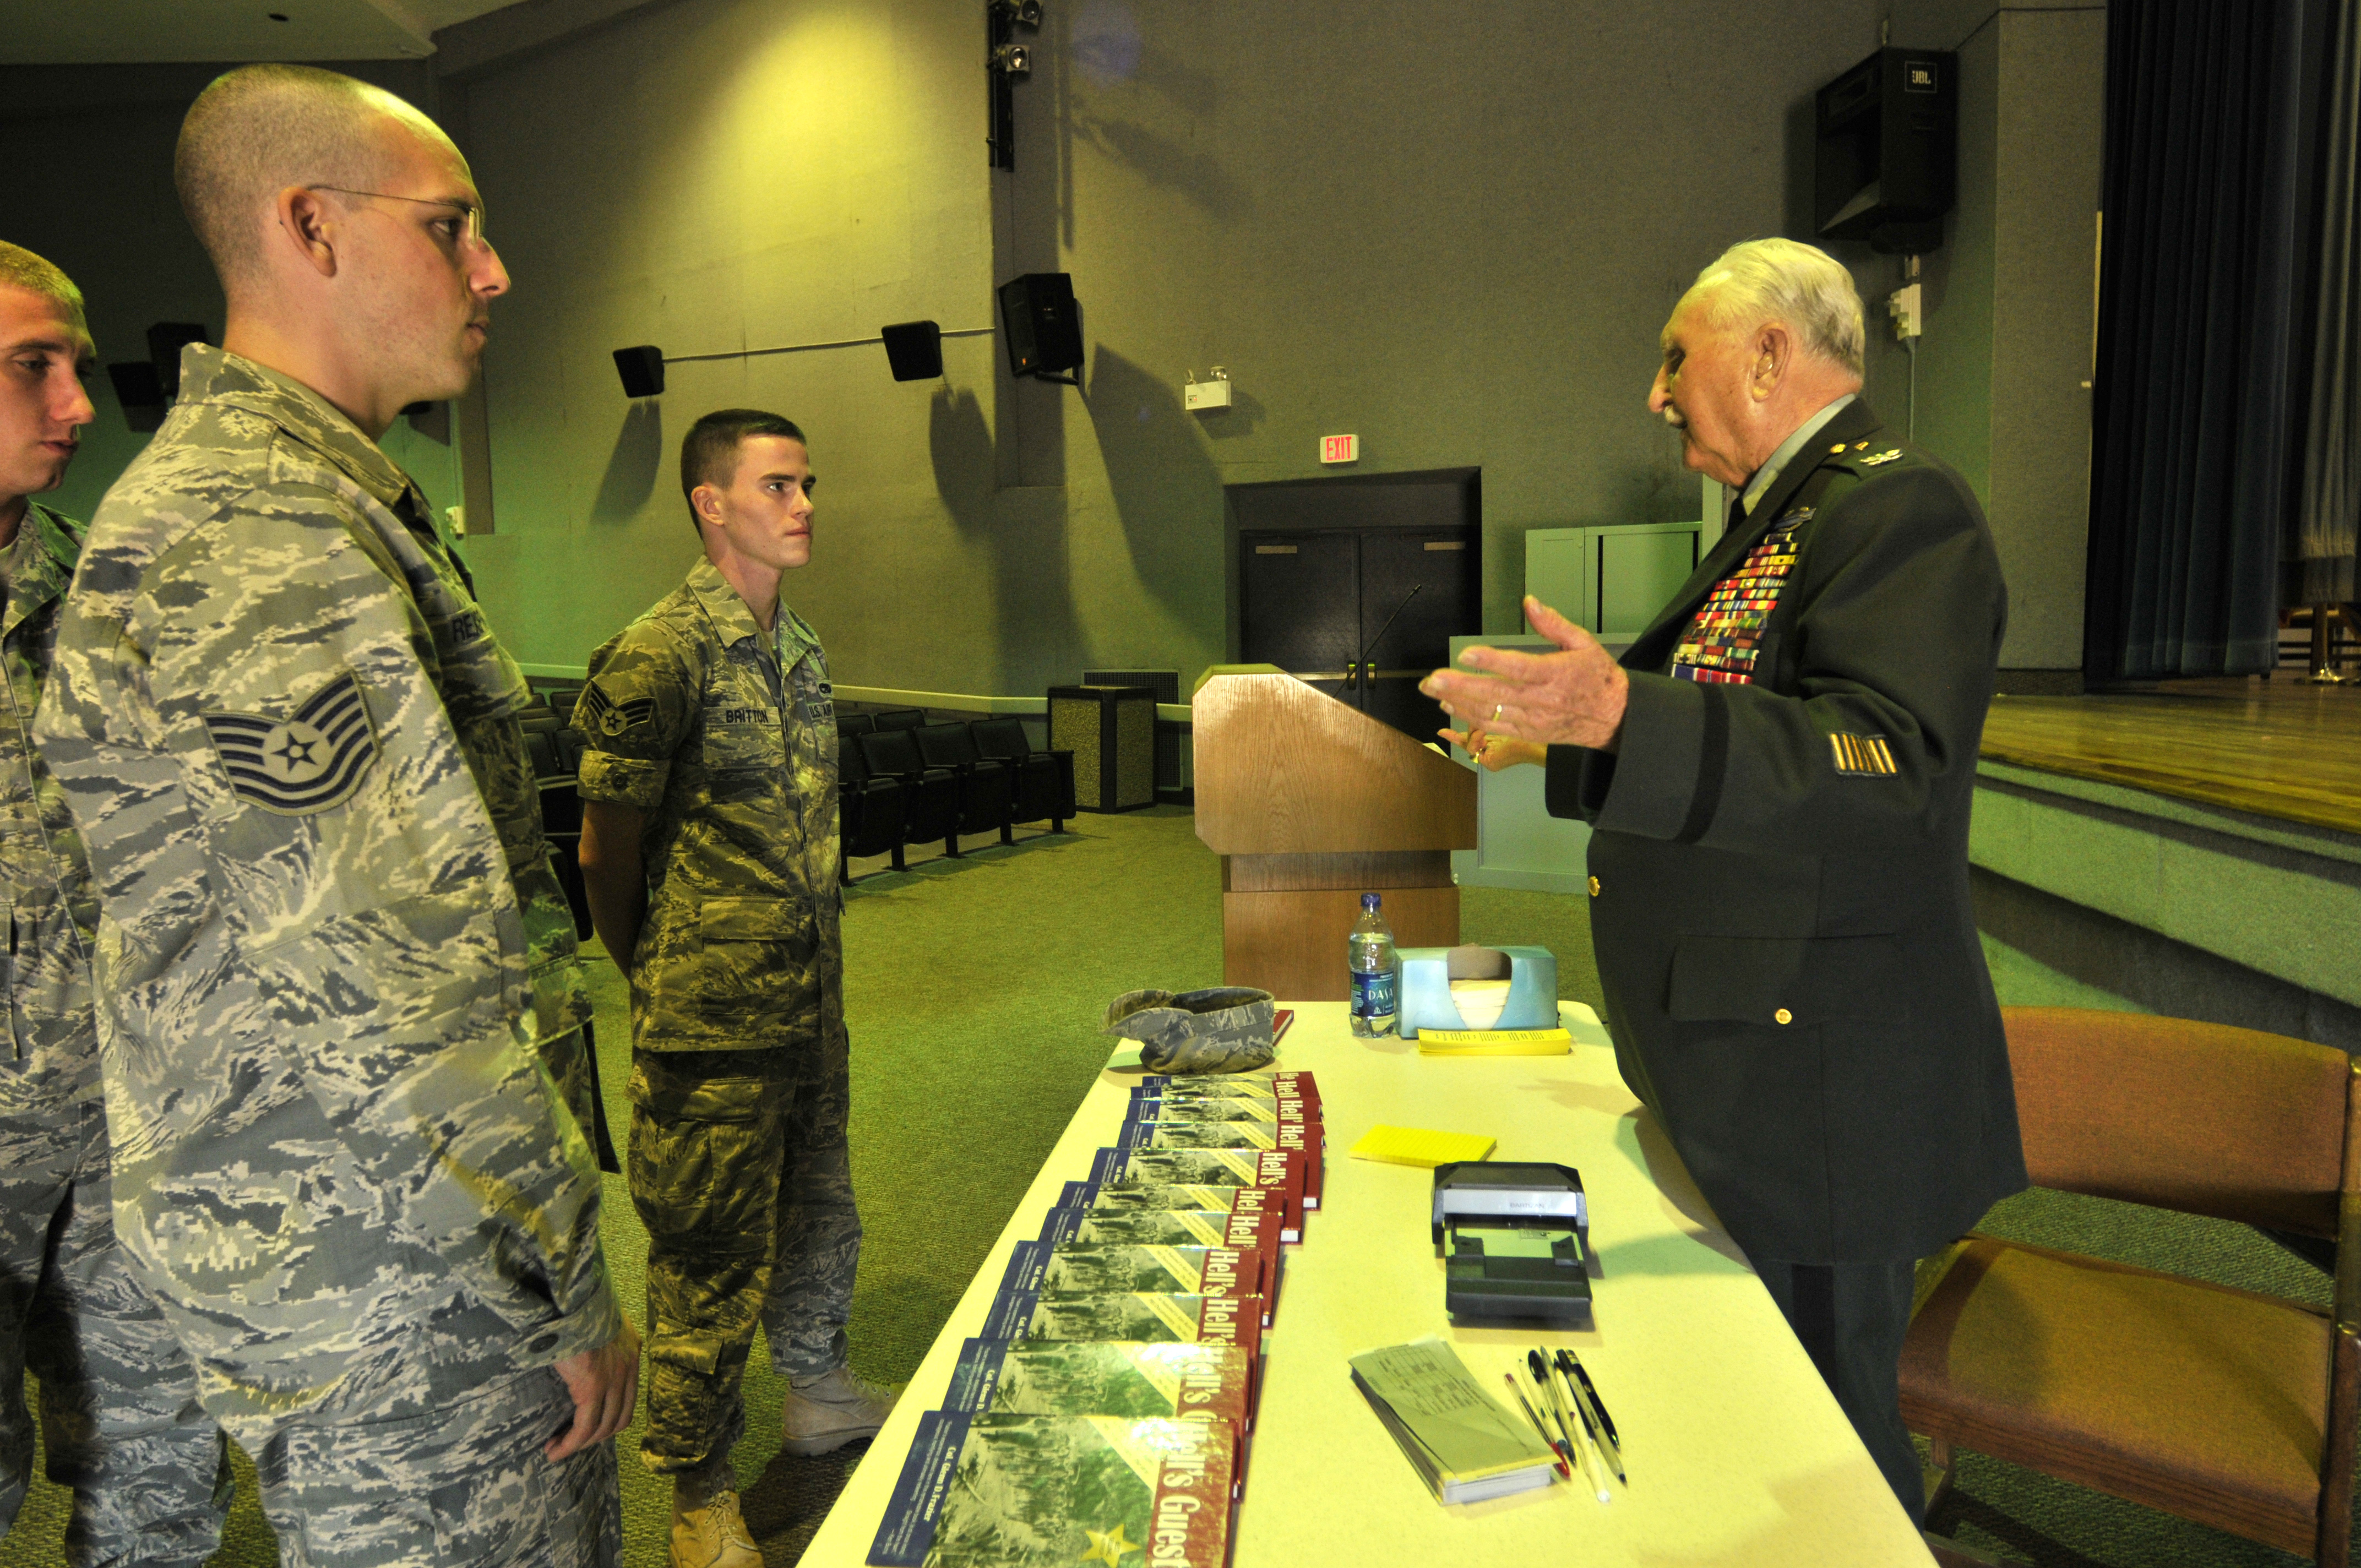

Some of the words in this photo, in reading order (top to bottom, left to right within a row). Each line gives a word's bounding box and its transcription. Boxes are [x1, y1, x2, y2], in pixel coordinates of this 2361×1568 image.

[1912, 70, 1931, 84] JBL
[1326, 436, 1352, 461] EXIT
[726, 710, 769, 723] BRITTON
[809, 705, 822, 718] U.S.
[1276, 1081, 1300, 1098] Hell
[1260, 1152, 1287, 1185] Hell's
[1237, 1190, 1266, 1211] Hel
[1203, 1251, 1239, 1295] Hell's
[985, 1369, 995, 1382] Col.
[1184, 1347, 1224, 1403] Hell's
[945, 1446, 957, 1461] Col.
[1163, 1422, 1209, 1488] Hell's
[937, 1462, 951, 1484] Glenn
[923, 1494, 940, 1522] Frazier
[1151, 1495, 1201, 1568] Guest
